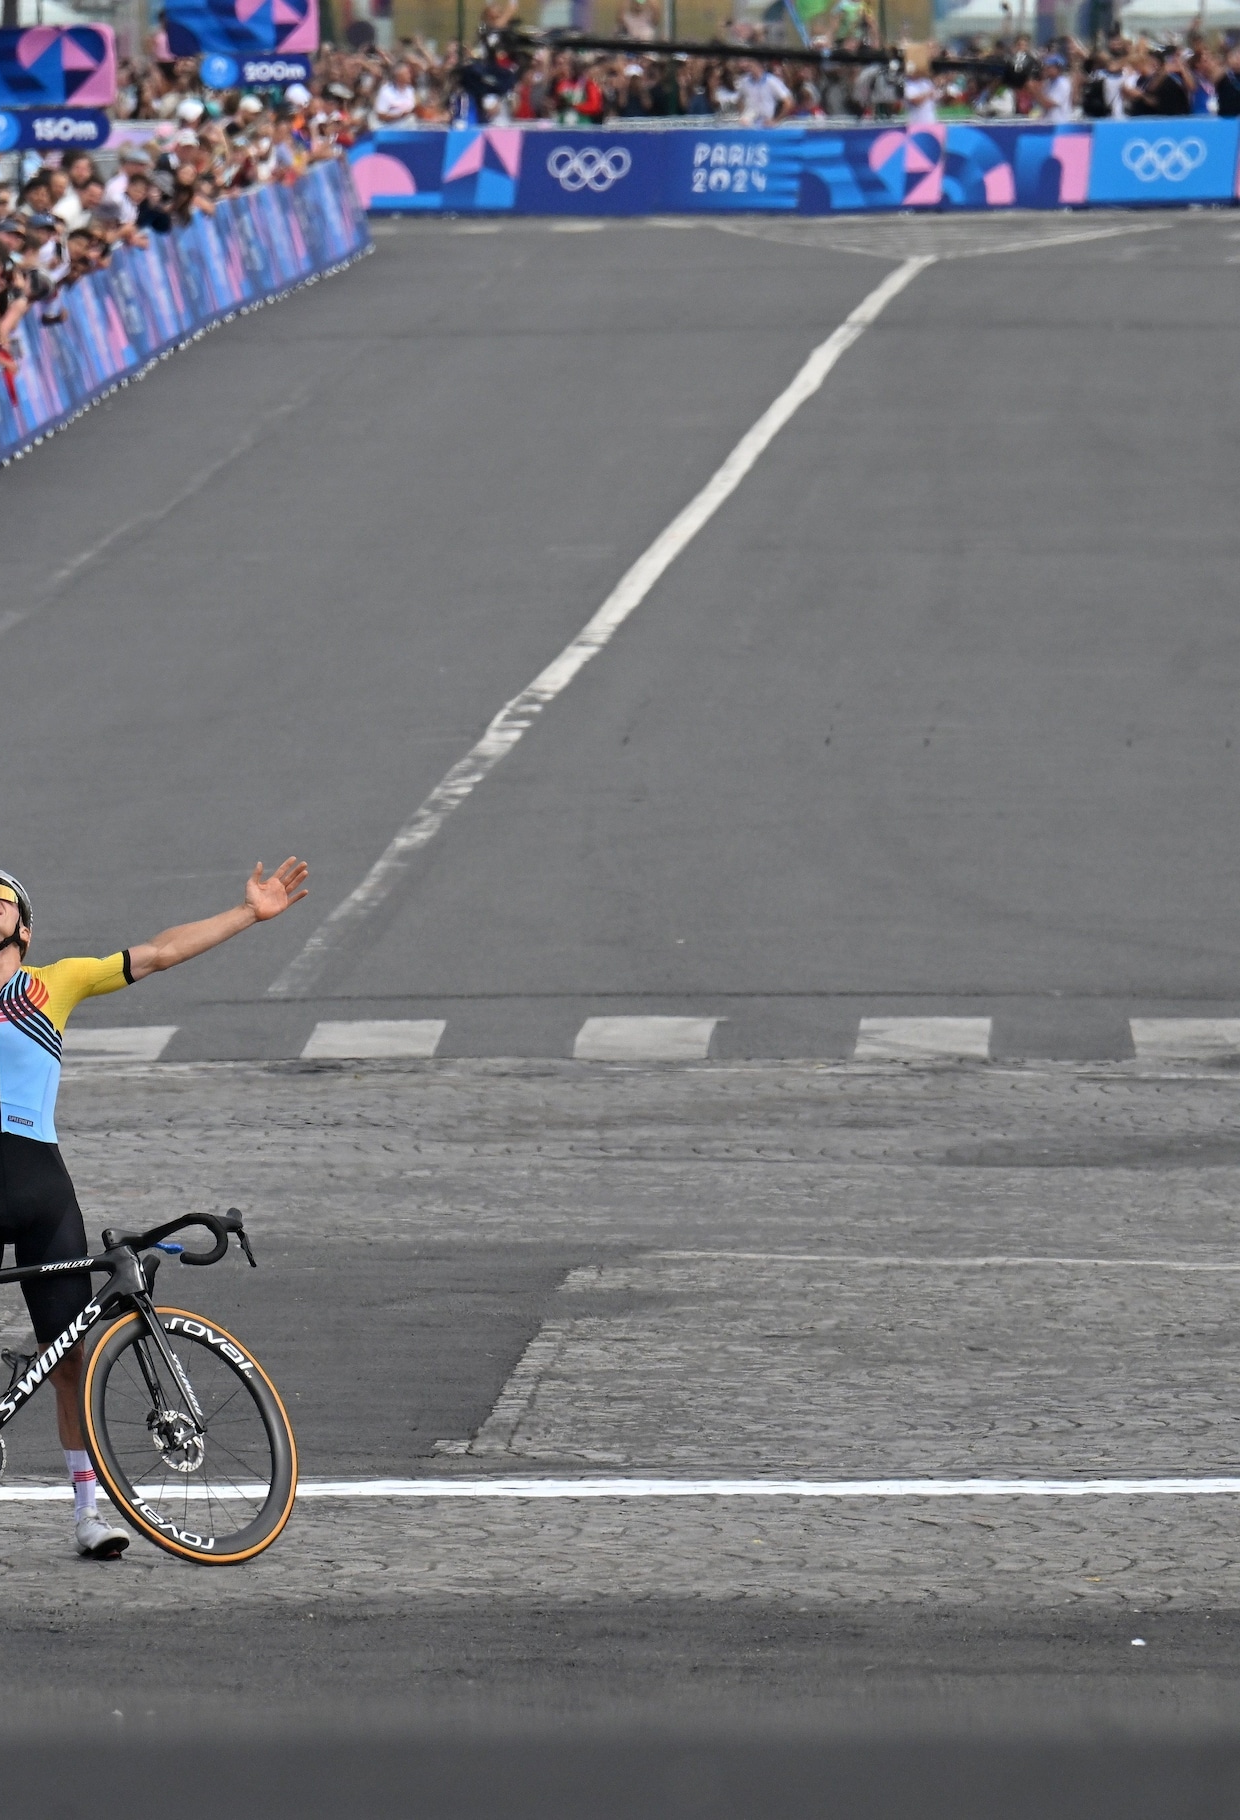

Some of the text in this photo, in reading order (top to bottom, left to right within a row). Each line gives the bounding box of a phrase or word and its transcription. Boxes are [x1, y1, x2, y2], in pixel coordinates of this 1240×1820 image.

[32, 117, 98, 141] 150m
[693, 142, 770, 168] PARIS
[692, 168, 767, 193] 2024
[40, 1259, 94, 1272] SPECIALIZED
[170, 1317, 254, 1370] roval
[0, 1297, 102, 1422] S-WORKS
[131, 1498, 215, 1549] roval
